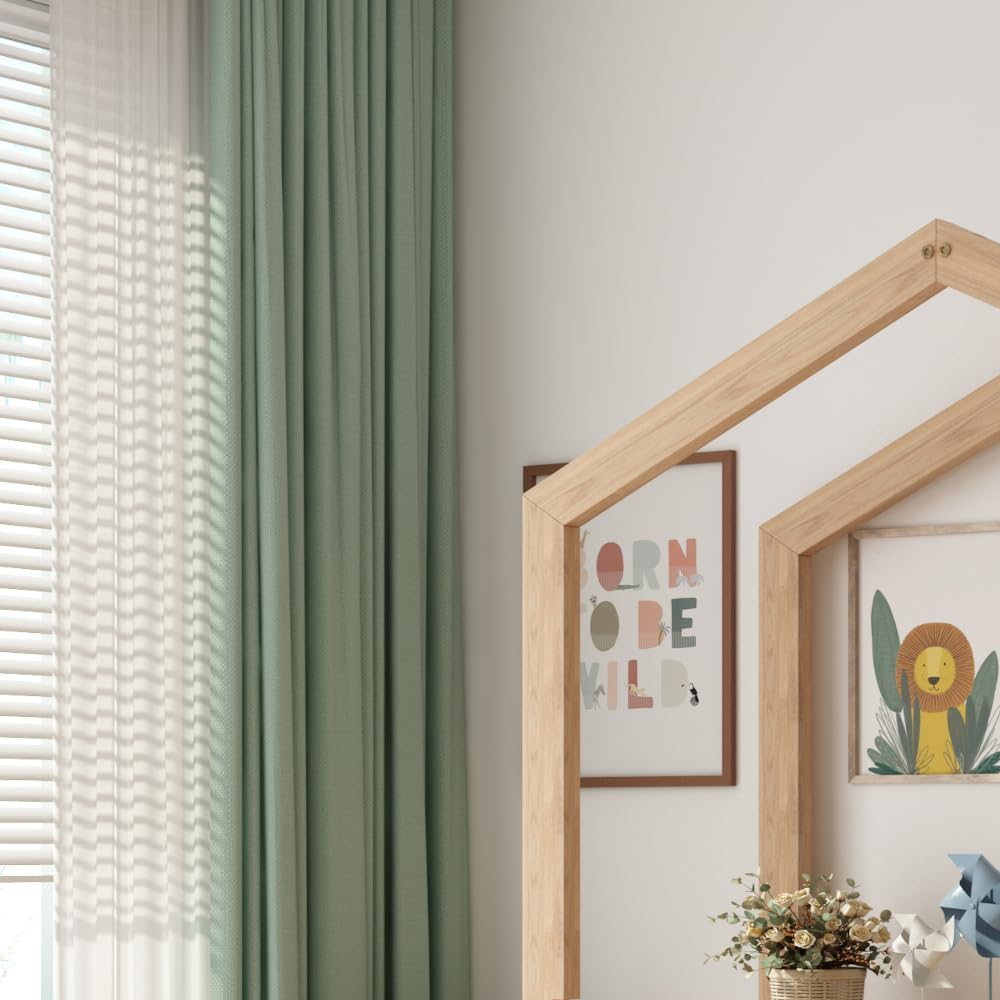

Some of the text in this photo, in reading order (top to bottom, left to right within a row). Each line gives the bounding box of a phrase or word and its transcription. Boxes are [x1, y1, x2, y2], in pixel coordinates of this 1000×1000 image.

[581, 538, 697, 592] ORN
[581, 597, 697, 652] O BE
